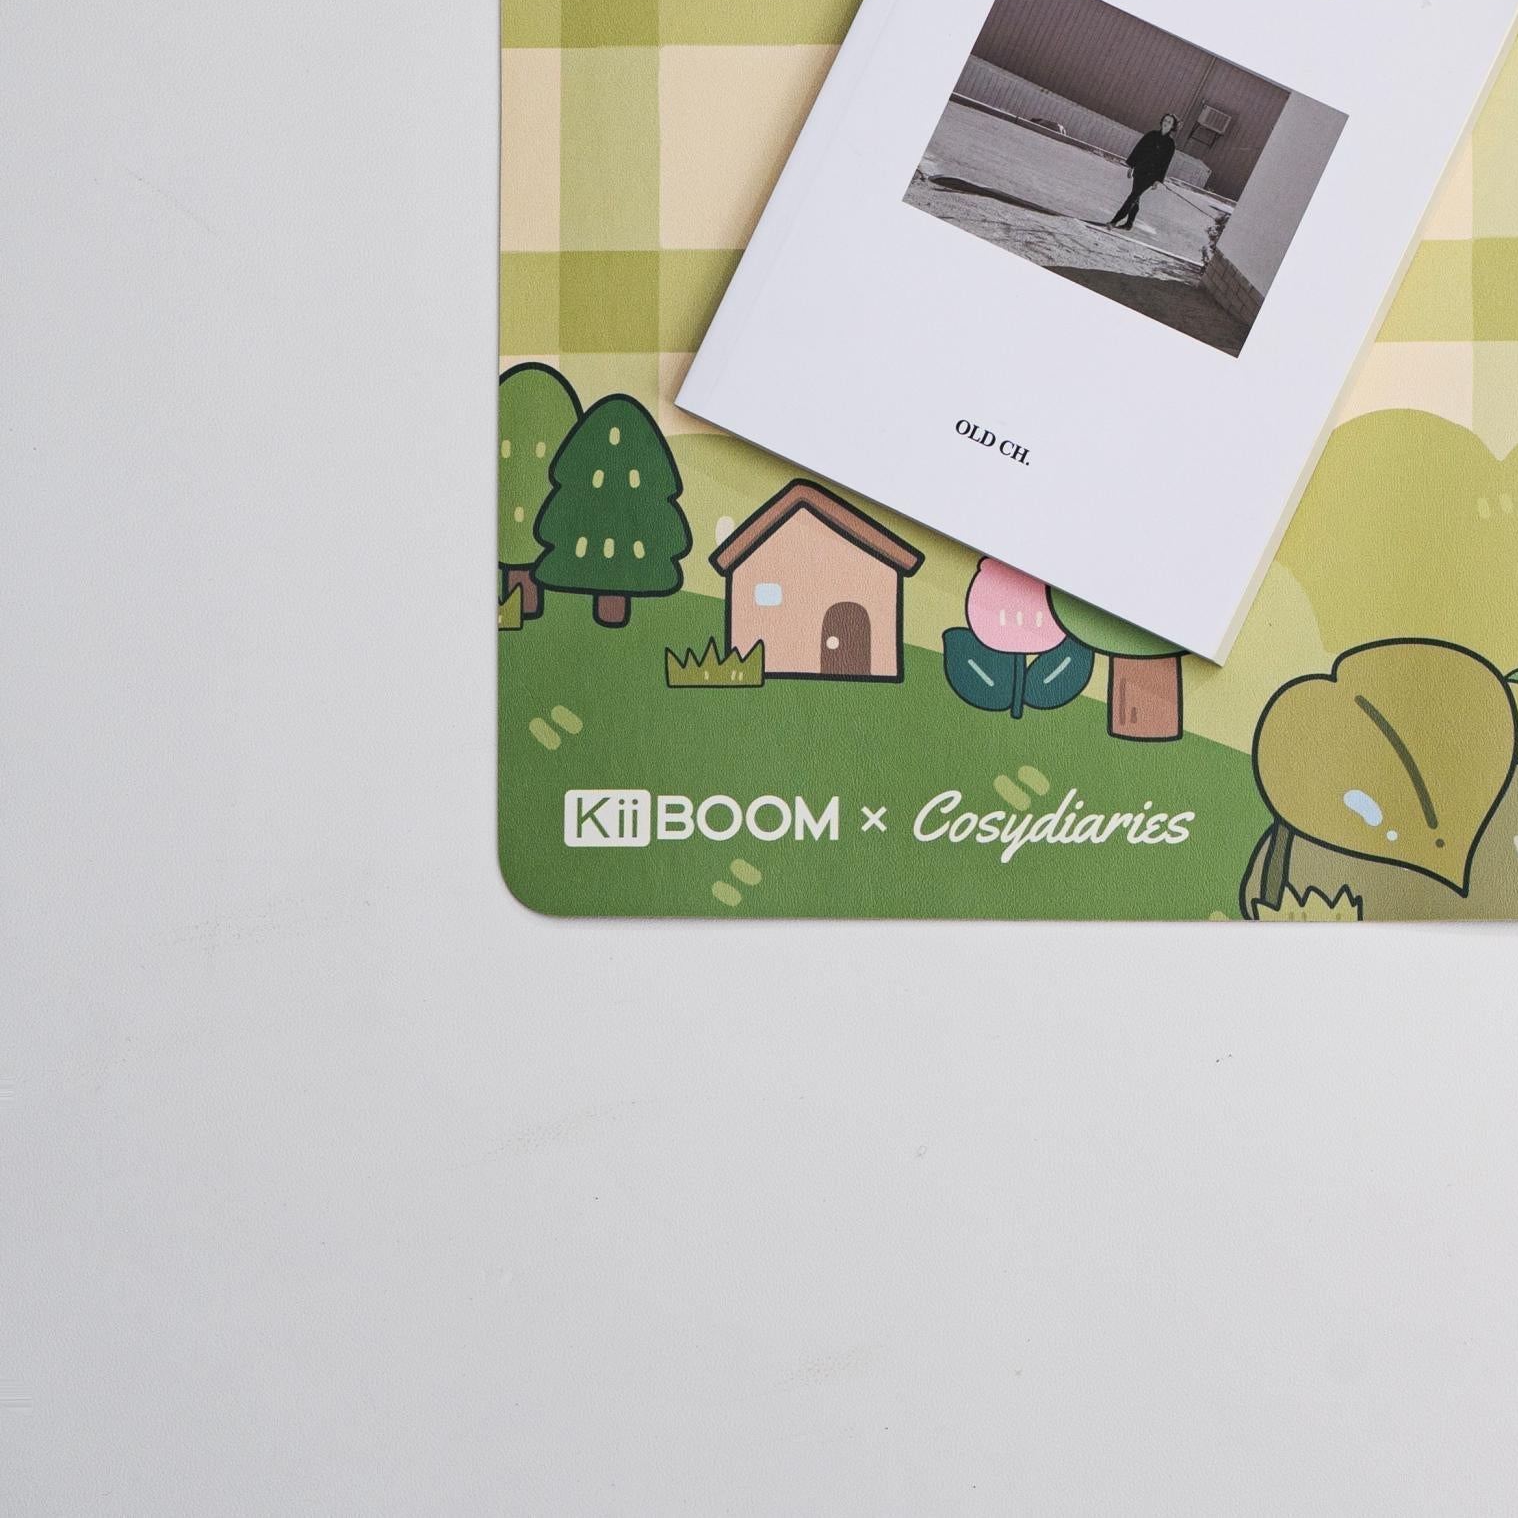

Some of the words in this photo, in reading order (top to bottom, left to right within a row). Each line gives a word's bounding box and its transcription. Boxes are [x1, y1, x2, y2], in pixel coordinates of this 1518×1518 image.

[954, 418, 997, 448] OLD
[998, 438, 1030, 467] CH.
[912, 788, 1195, 863] Cosydiaries
